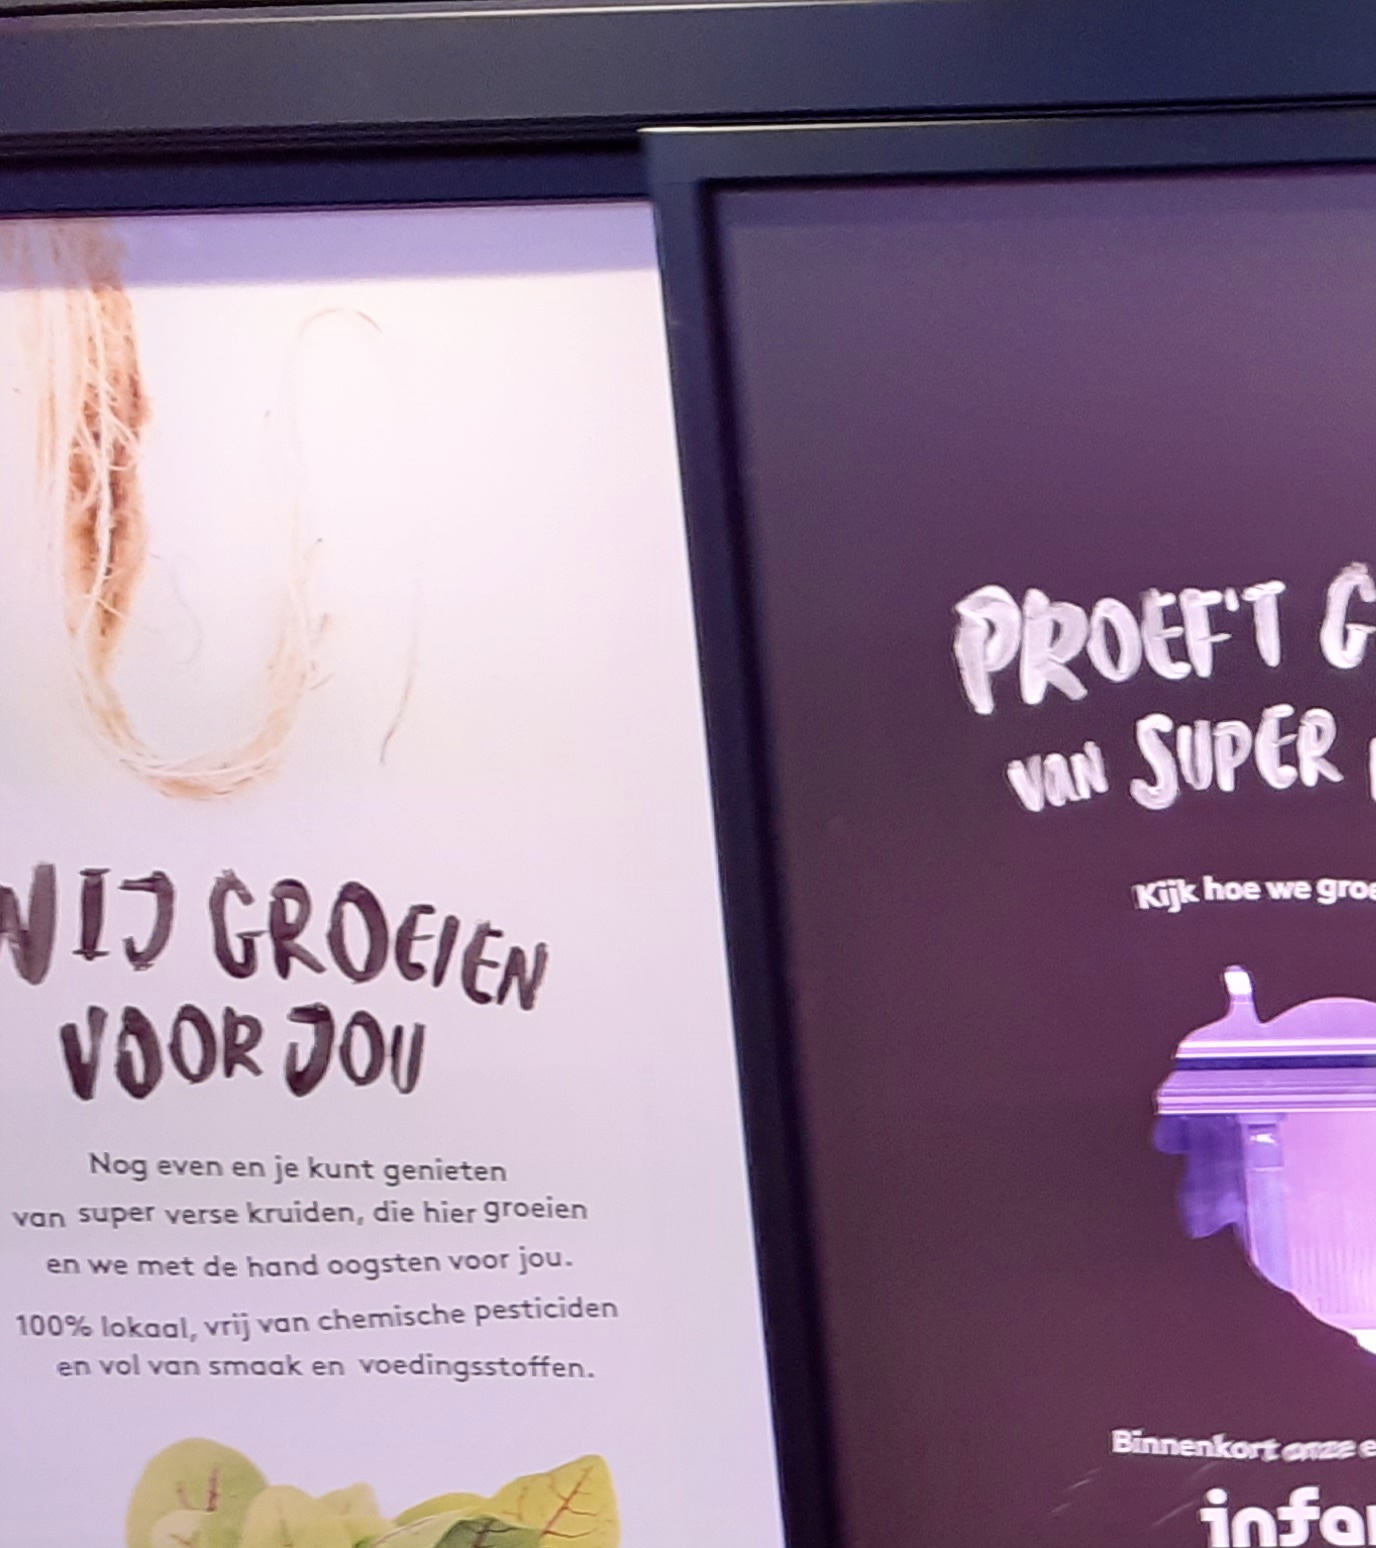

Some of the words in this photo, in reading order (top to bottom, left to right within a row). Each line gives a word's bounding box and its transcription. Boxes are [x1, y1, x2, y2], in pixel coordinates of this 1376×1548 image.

[954, 581, 1286, 715] PROEF'T
[1130, 703, 1344, 810] SUPER
[1134, 878, 1200, 914] Kijk
[1202, 875, 1262, 901] hoe
[1264, 880, 1313, 900] we
[206, 870, 549, 1011] GROEIEN
[59, 1003, 263, 1102] VOOR
[285, 1002, 425, 1098] JOU
[89, 1151, 148, 1182] Nog
[157, 1159, 223, 1177] even
[231, 1161, 266, 1177] en
[273, 1154, 299, 1185] je
[308, 1156, 375, 1180] kunt
[383, 1157, 507, 1187] genieten
[12, 1212, 66, 1228] van
[78, 1206, 155, 1230] super
[164, 1208, 239, 1225] verse
[246, 1200, 364, 1226] kruiden,
[373, 1200, 414, 1223] die
[423, 1200, 477, 1224] hier
[483, 1195, 587, 1224] groeien
[46, 1258, 80, 1274] en
[87, 1259, 128, 1275] we
[137, 1256, 195, 1277] met
[203, 1255, 238, 1278] de
[246, 1253, 319, 1278] hand
[327, 1253, 441, 1281] oogsten
[448, 1253, 510, 1270] voor
[519, 1245, 573, 1276] jou.
[15, 1314, 93, 1337] 100%
[101, 1315, 197, 1343] lokaal,
[203, 1312, 251, 1343] vrij
[257, 1316, 310, 1333] van
[317, 1303, 466, 1331] chemische
[474, 1296, 618, 1327] pesticiden
[56, 1360, 91, 1377] en
[98, 1353, 141, 1376] vol
[147, 1360, 200, 1376] van
[208, 1354, 303, 1376] smaak
[311, 1360, 345, 1376] en
[358, 1352, 594, 1383] voedingsstoffen.
[1112, 1429, 1281, 1462] Binnenkort
